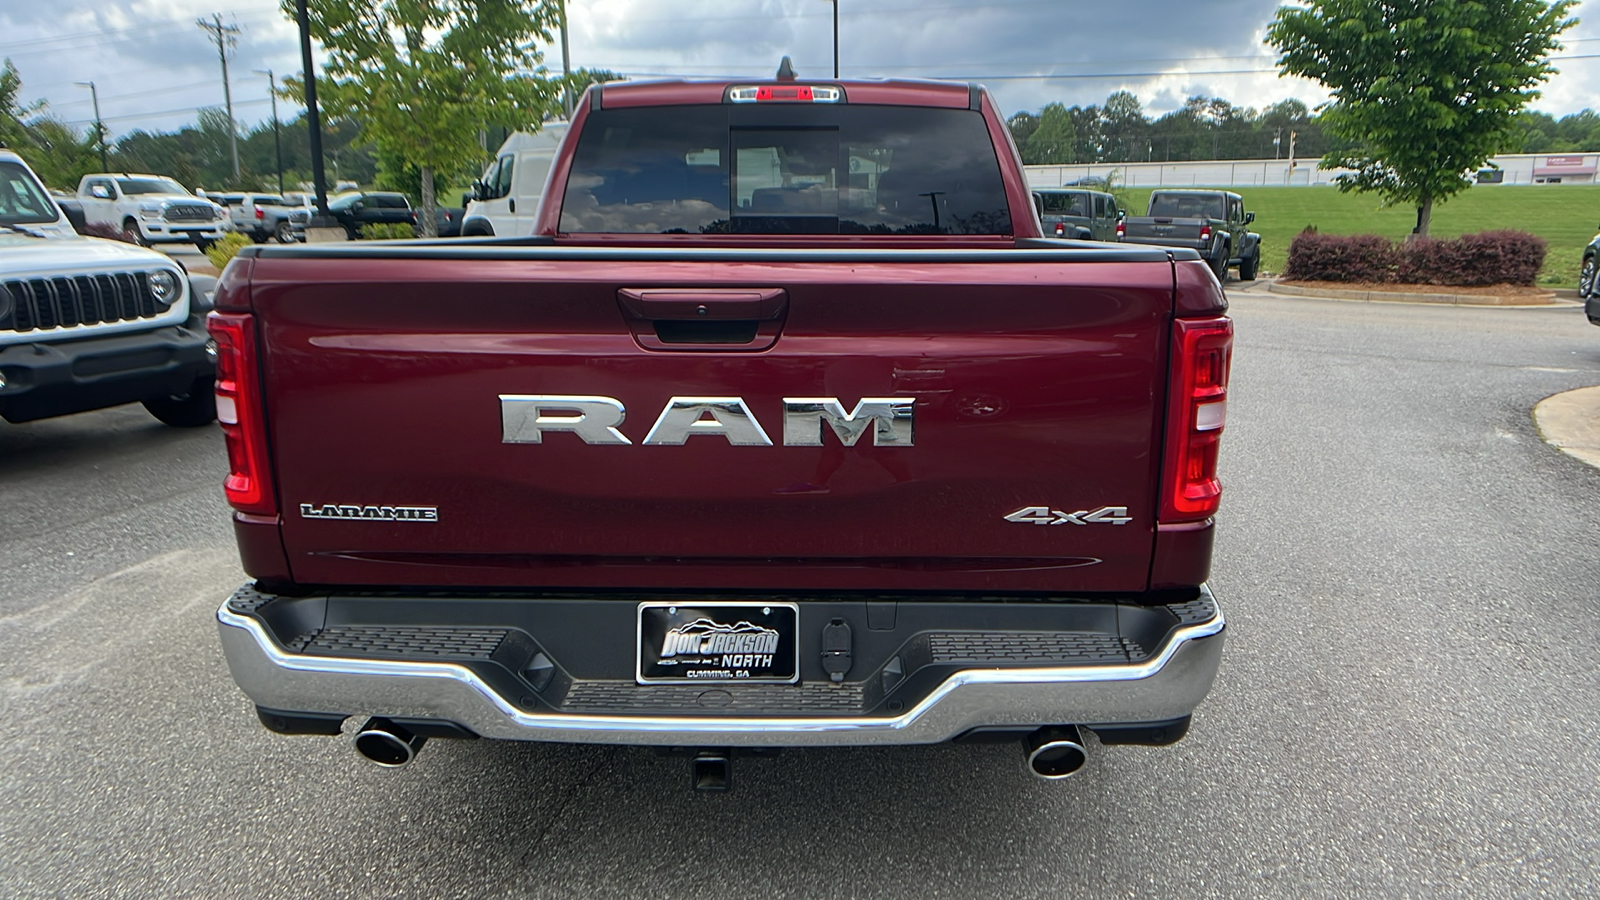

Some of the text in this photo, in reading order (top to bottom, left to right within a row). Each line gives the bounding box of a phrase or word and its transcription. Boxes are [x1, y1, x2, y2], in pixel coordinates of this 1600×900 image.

[499, 394, 916, 447] RAM
[300, 503, 438, 522] LARAMIE
[1003, 506, 1133, 525] 4x4
[661, 632, 779, 657] DON JACKSON
[721, 655, 773, 667] NORTH
[686, 670, 750, 678] CUMMING, GA
